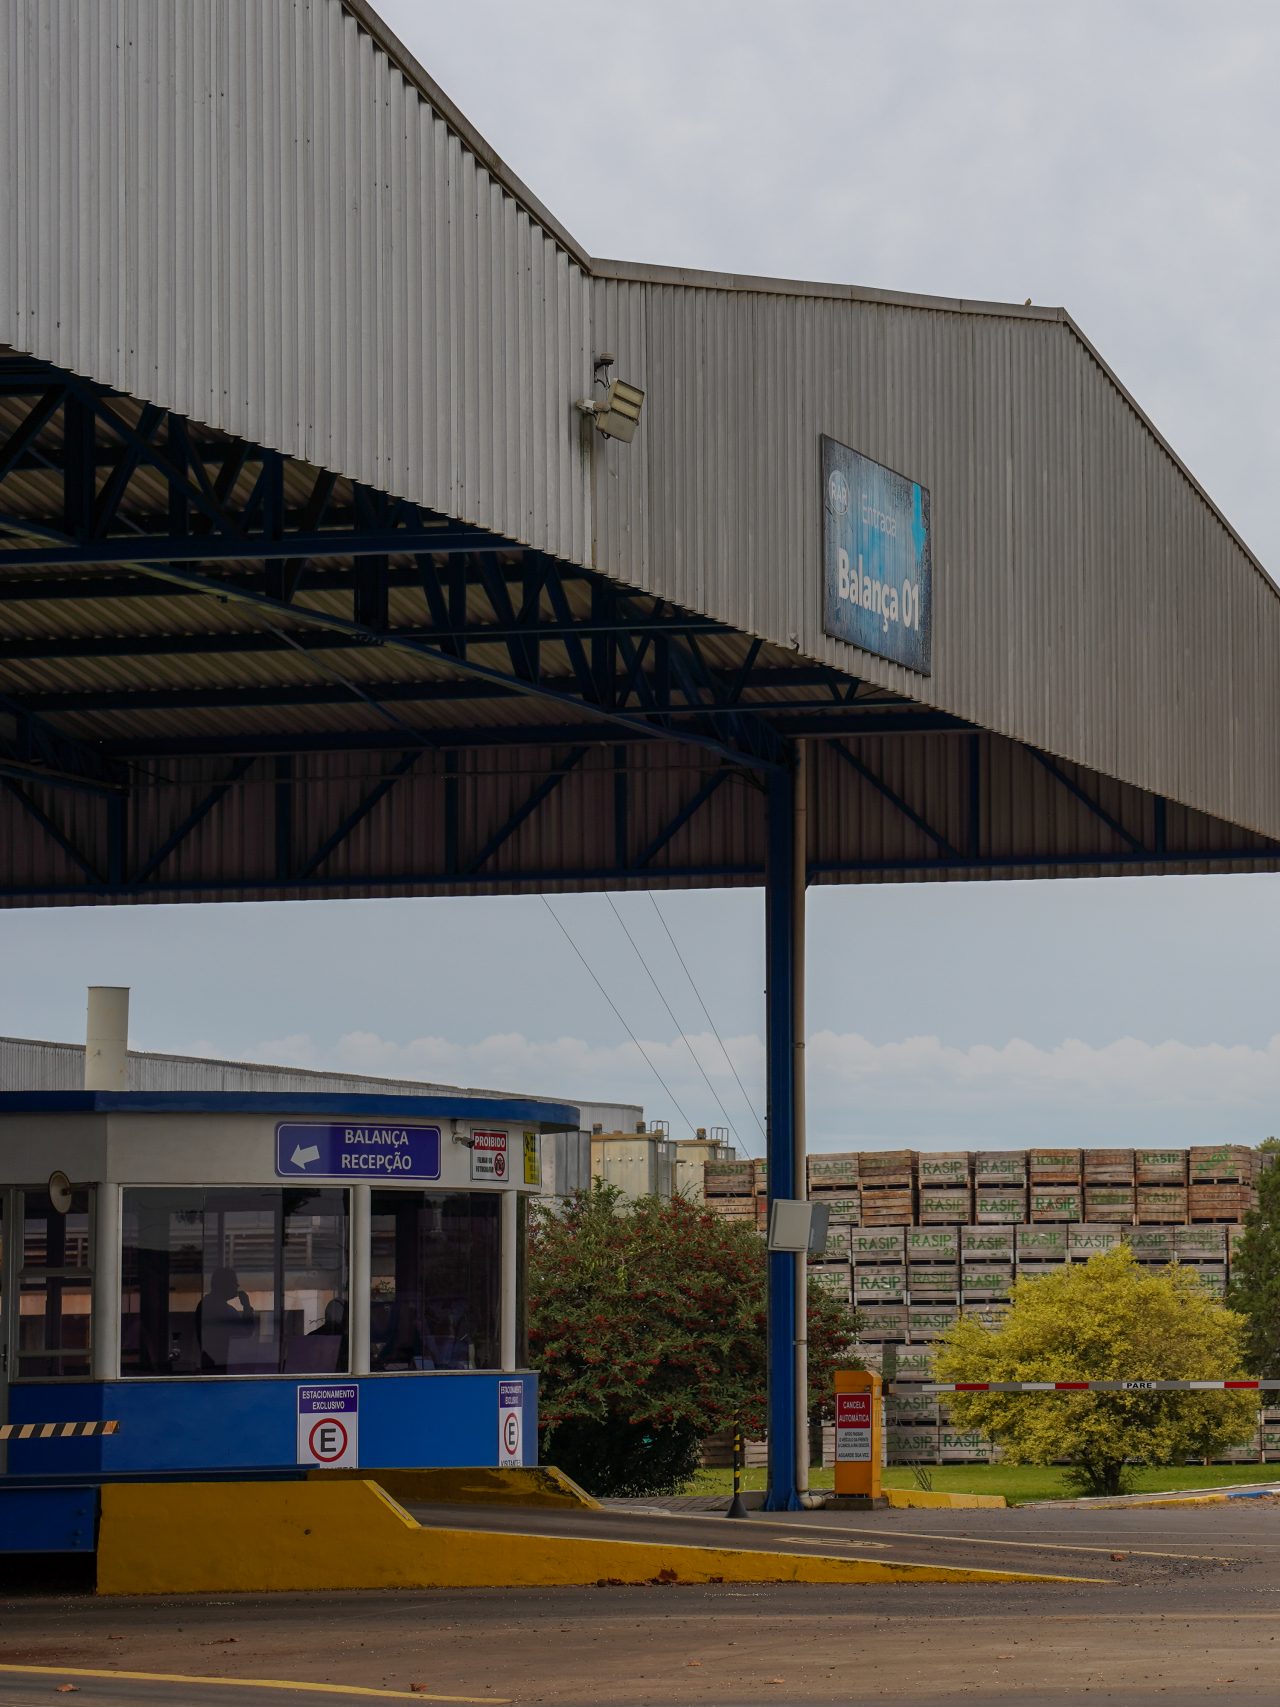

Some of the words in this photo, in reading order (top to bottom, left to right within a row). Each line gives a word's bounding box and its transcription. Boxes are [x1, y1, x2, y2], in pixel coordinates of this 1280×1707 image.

[830, 481, 848, 505] RAR
[862, 494, 897, 538] Entrada
[837, 547, 899, 633] Balança
[901, 578, 920, 631] 01
[345, 1129, 409, 1148] BALANÇA
[474, 1136, 506, 1148] PROIBIDO
[341, 1152, 412, 1173] RECEPÇÃO
[1142, 1153, 1180, 1164] RASIP
[812, 1162, 853, 1175] RASIP
[922, 1161, 962, 1174] RASIP
[978, 1160, 1020, 1173] RASIP
[925, 1199, 965, 1211] RASIP
[980, 1199, 1020, 1211] RASIP
[1035, 1197, 1076, 1210] RASIP
[1012, 1212, 1022, 1221] 15
[858, 1237, 898, 1250] RASIP
[911, 1234, 952, 1247] RASIP
[967, 1237, 1008, 1249] RASIP
[1021, 1231, 1062, 1245] RASIP
[1073, 1233, 1115, 1248] RASIP
[943, 1247, 954, 1256] 22
[860, 1276, 901, 1289] RASIP
[913, 1271, 951, 1283] RASIP
[964, 1274, 1004, 1287] RASIP
[912, 1315, 953, 1327] RASIP
[302, 1389, 355, 1399] ESTACIONAMENTO
[313, 1401, 345, 1410] EXCLUSIVO
[843, 1401, 865, 1409] CANCELA
[895, 1396, 932, 1410] RASIP
[839, 1412, 870, 1422] AUTOMÁTICA
[508, 1422, 515, 1445] E
[320, 1428, 337, 1453] E
[895, 1436, 932, 1449] RASIP
[975, 1449, 987, 1457] 20
